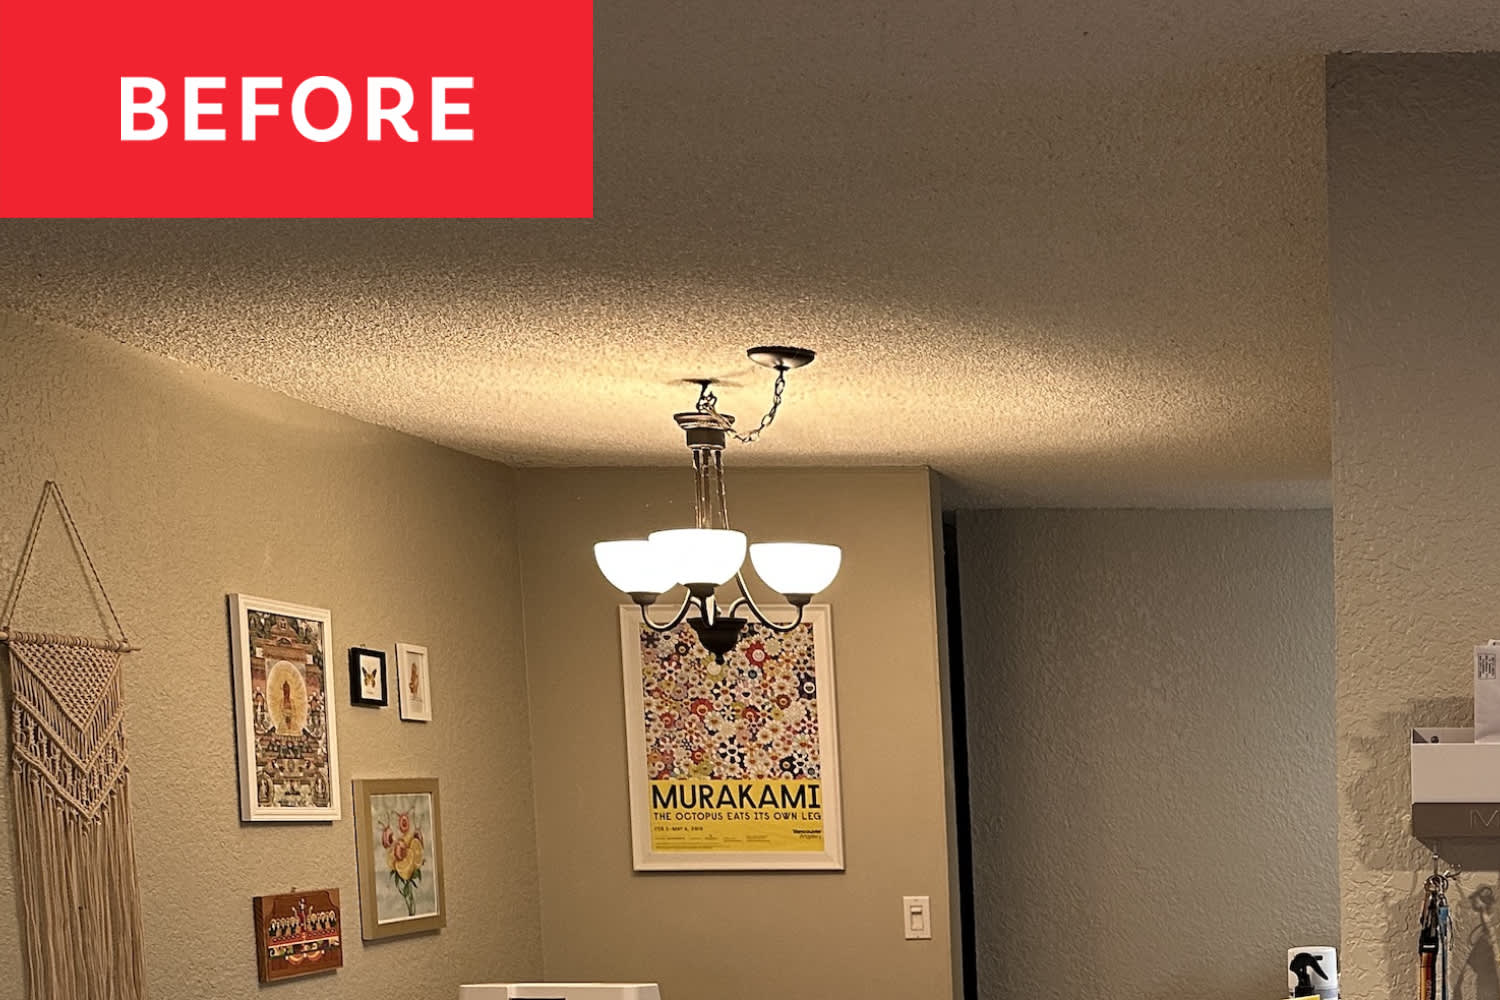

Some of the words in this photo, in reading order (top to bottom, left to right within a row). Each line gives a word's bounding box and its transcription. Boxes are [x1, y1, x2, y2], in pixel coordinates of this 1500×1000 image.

[651, 784, 821, 809] MURAKAMI
[653, 811, 671, 821] THE
[675, 811, 724, 821] OCTOPUS
[727, 811, 751, 821] EATS
[753, 811, 770, 821] ITS
[773, 811, 798, 821] OWN
[801, 811, 822, 821] LEG
